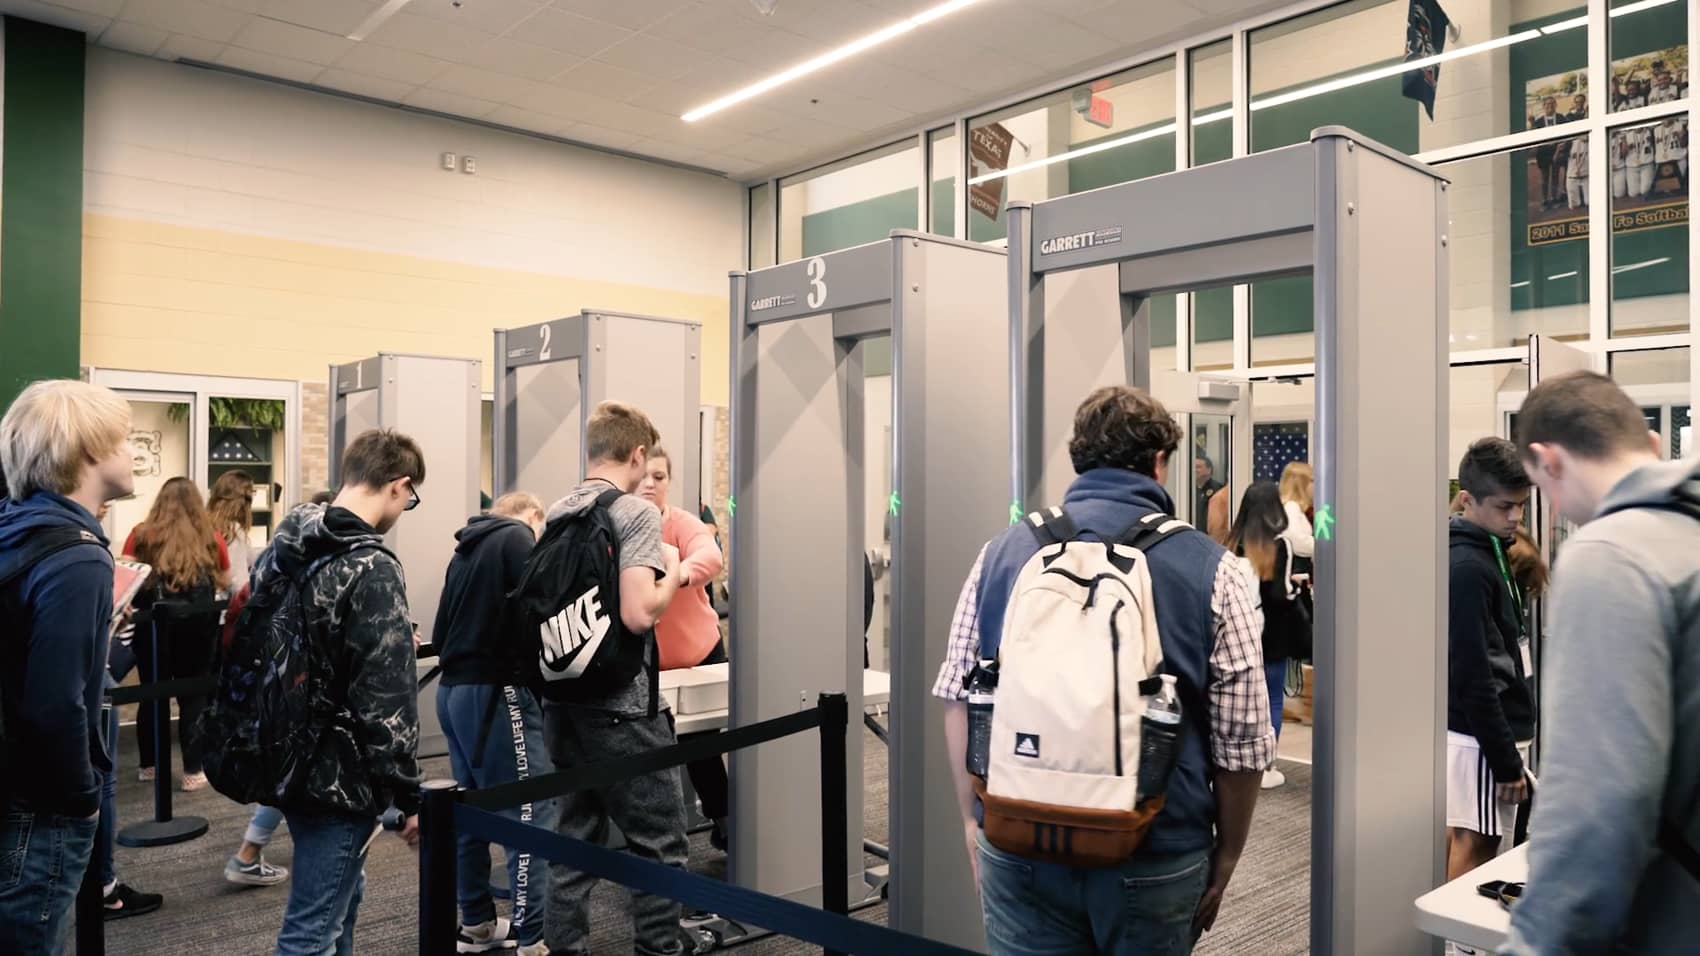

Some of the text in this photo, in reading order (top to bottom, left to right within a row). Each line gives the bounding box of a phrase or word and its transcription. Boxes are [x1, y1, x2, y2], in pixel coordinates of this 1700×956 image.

[973, 130, 1002, 159] TEXAS
[1532, 223, 1565, 240] 2011
[1568, 221, 1589, 235] Sa
[1614, 214, 1634, 228] Fe
[1041, 231, 1095, 254] GARRETT
[807, 257, 827, 309] 3
[540, 324, 551, 361] 2
[356, 361, 362, 389] 1
[540, 585, 610, 664] NIKE
[508, 704, 522, 721] MY
[512, 720, 525, 744] LIFE
[515, 743, 529, 770] LOVE
[518, 770, 530, 781] Y
[520, 803, 533, 821] RU
[517, 858, 530, 888] LOVE
[516, 889, 528, 906] MY
